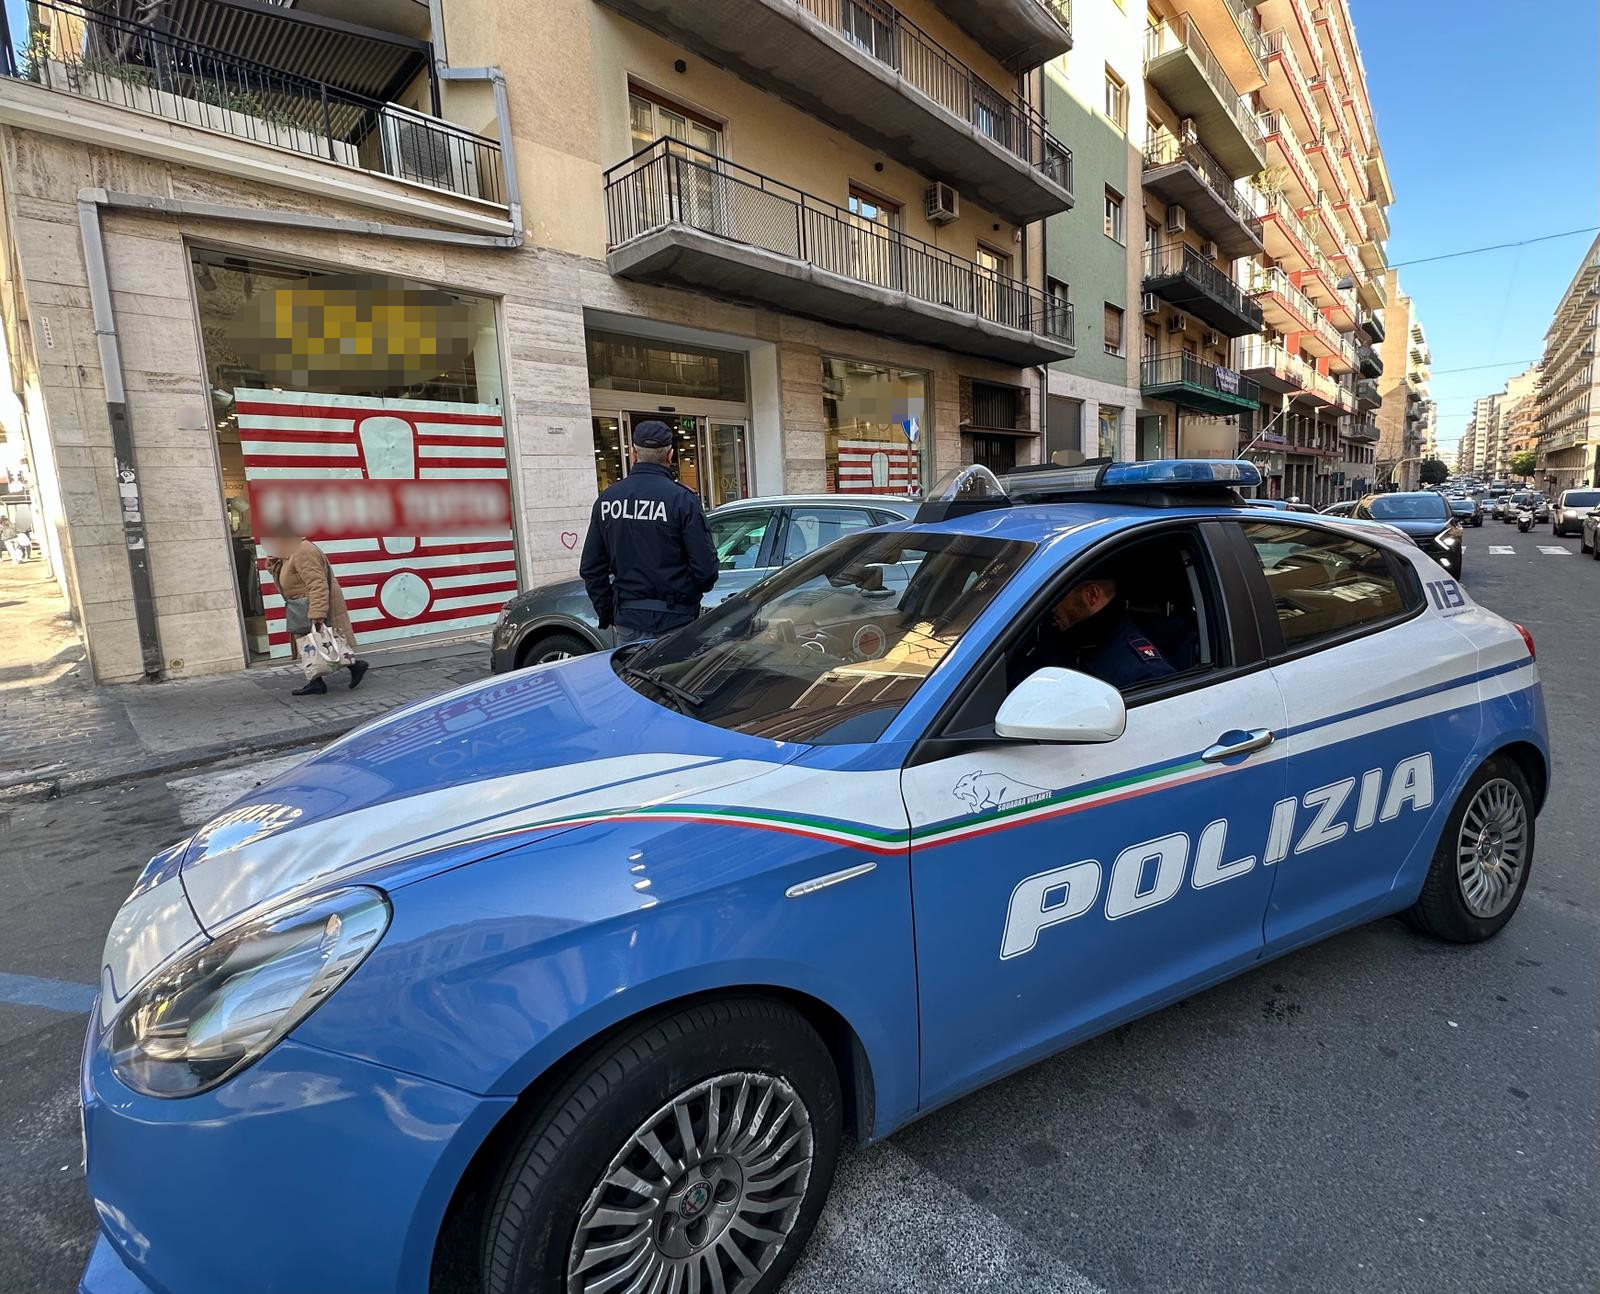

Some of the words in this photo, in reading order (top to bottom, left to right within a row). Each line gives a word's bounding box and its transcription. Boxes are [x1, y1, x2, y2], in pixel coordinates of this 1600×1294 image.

[601, 499, 667, 522] POLIZIA
[1425, 579, 1465, 610] 113
[1001, 752, 1434, 960] POLIZIA
